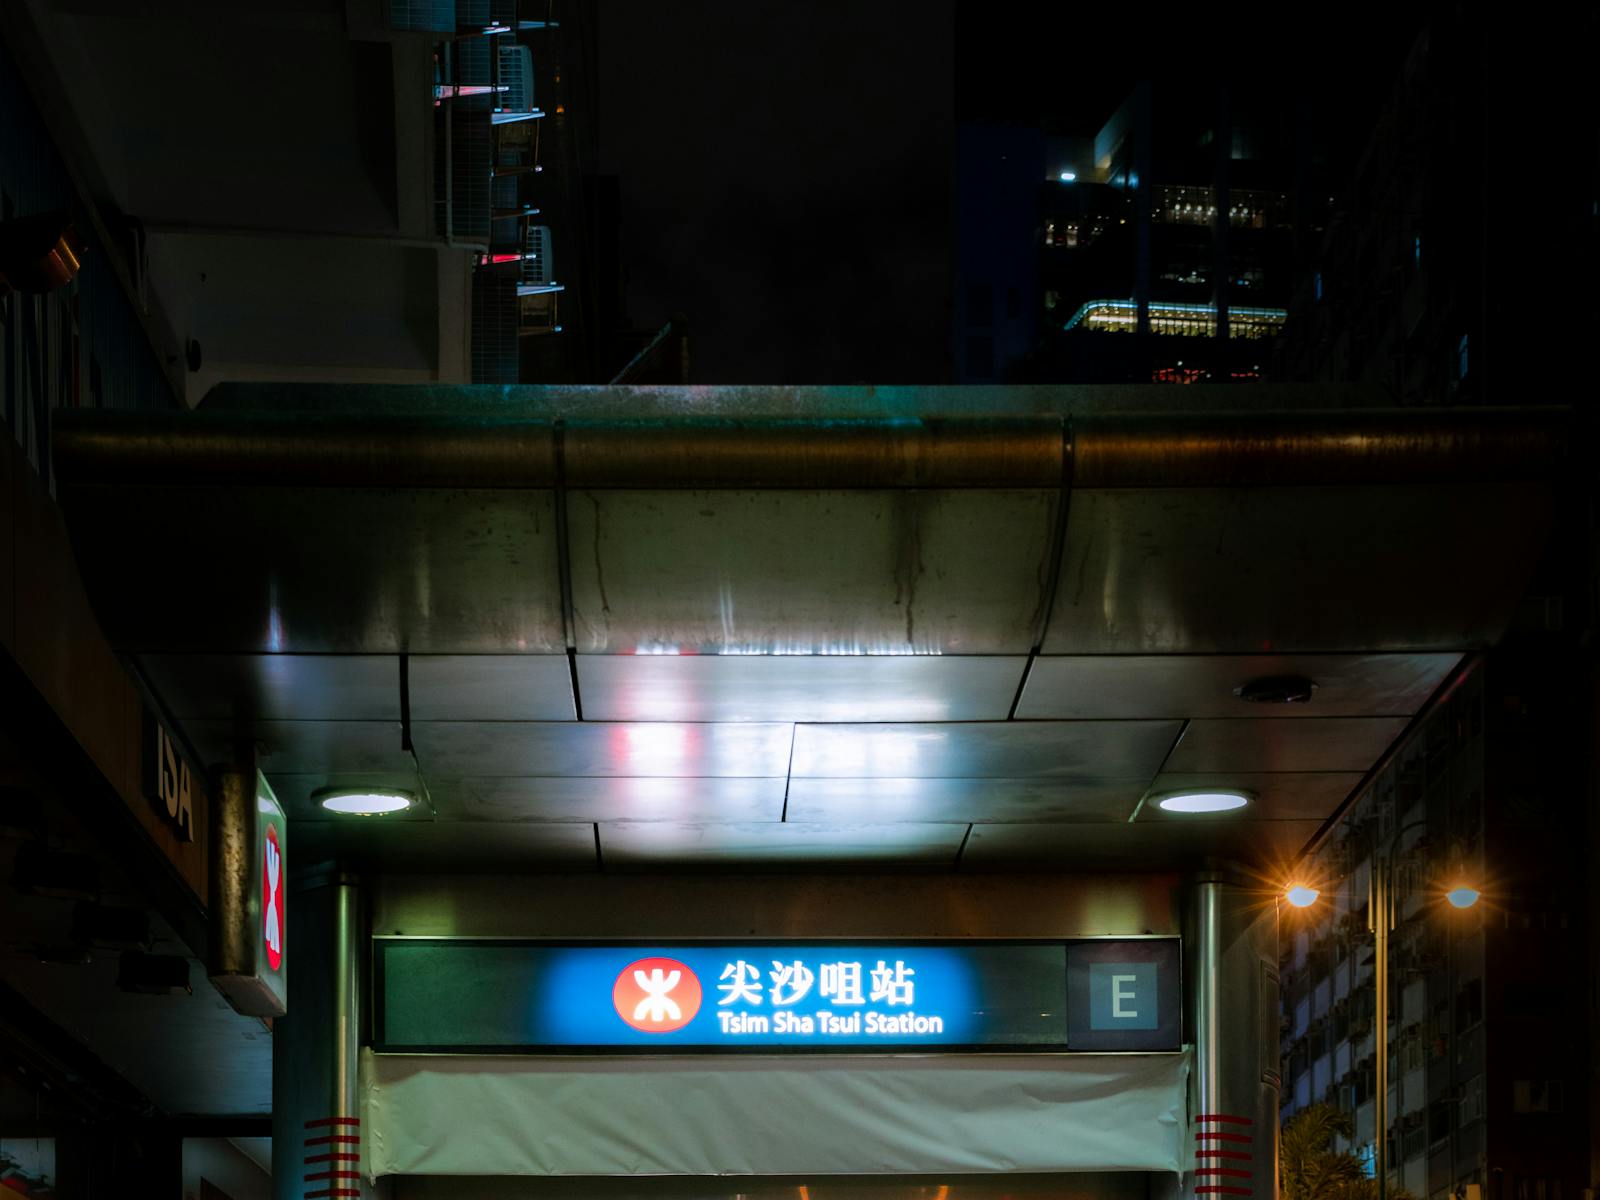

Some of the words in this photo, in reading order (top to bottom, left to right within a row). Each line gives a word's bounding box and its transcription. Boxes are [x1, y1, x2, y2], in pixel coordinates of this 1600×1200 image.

[717, 960, 915, 1006] 尖沙咀站
[1112, 975, 1137, 1018] E
[717, 1011, 769, 1034] Tsim
[773, 1011, 814, 1034] Sha
[816, 1011, 861, 1034] Tsui
[865, 1011, 943, 1034] Station
